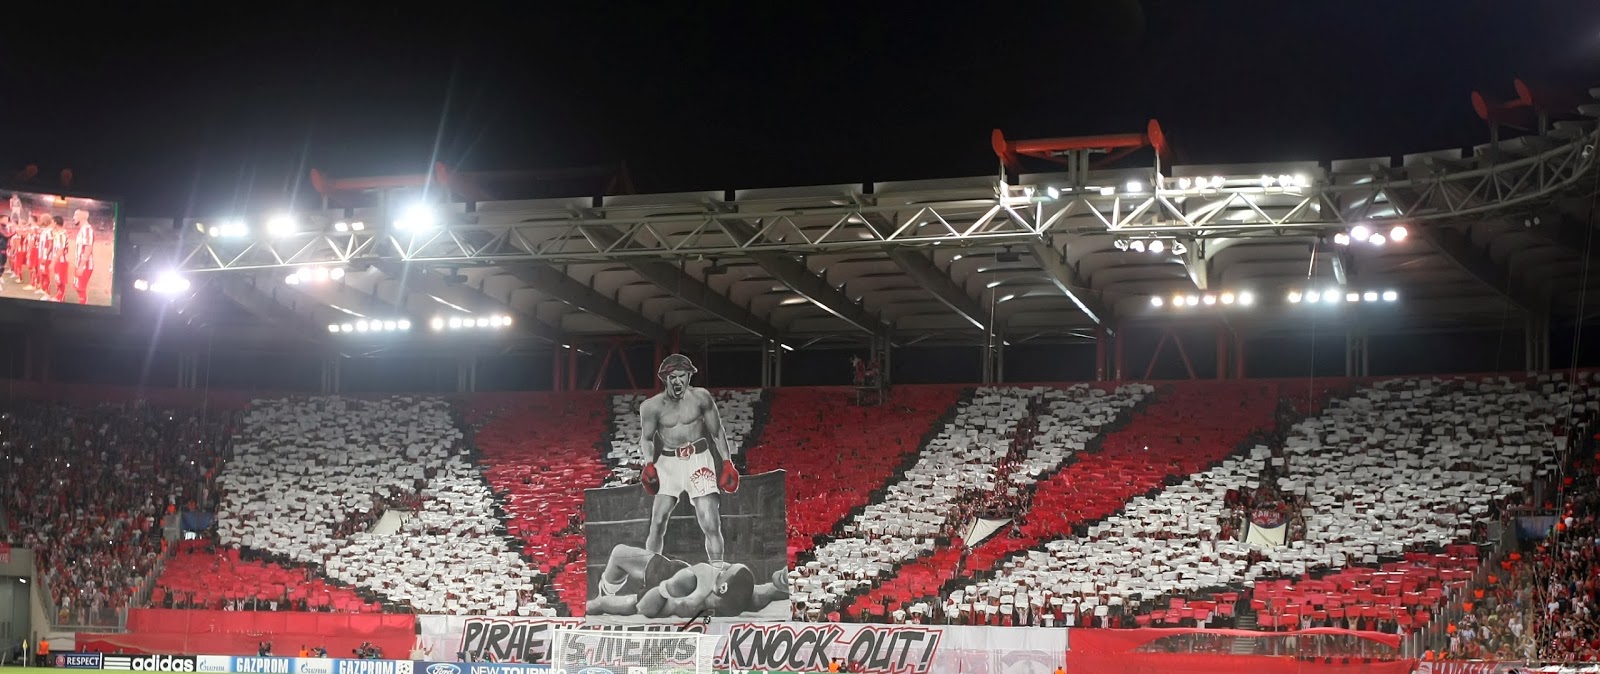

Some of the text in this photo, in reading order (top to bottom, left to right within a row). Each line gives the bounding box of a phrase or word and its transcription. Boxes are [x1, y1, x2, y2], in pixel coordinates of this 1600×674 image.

[847, 629, 938, 671] OUT!
[66, 657, 100, 666] RESPECT
[132, 654, 194, 673] adidas
[236, 657, 289, 673] GAZPROM
[339, 660, 395, 674] GAZPROM
[470, 666, 499, 674] NEW
